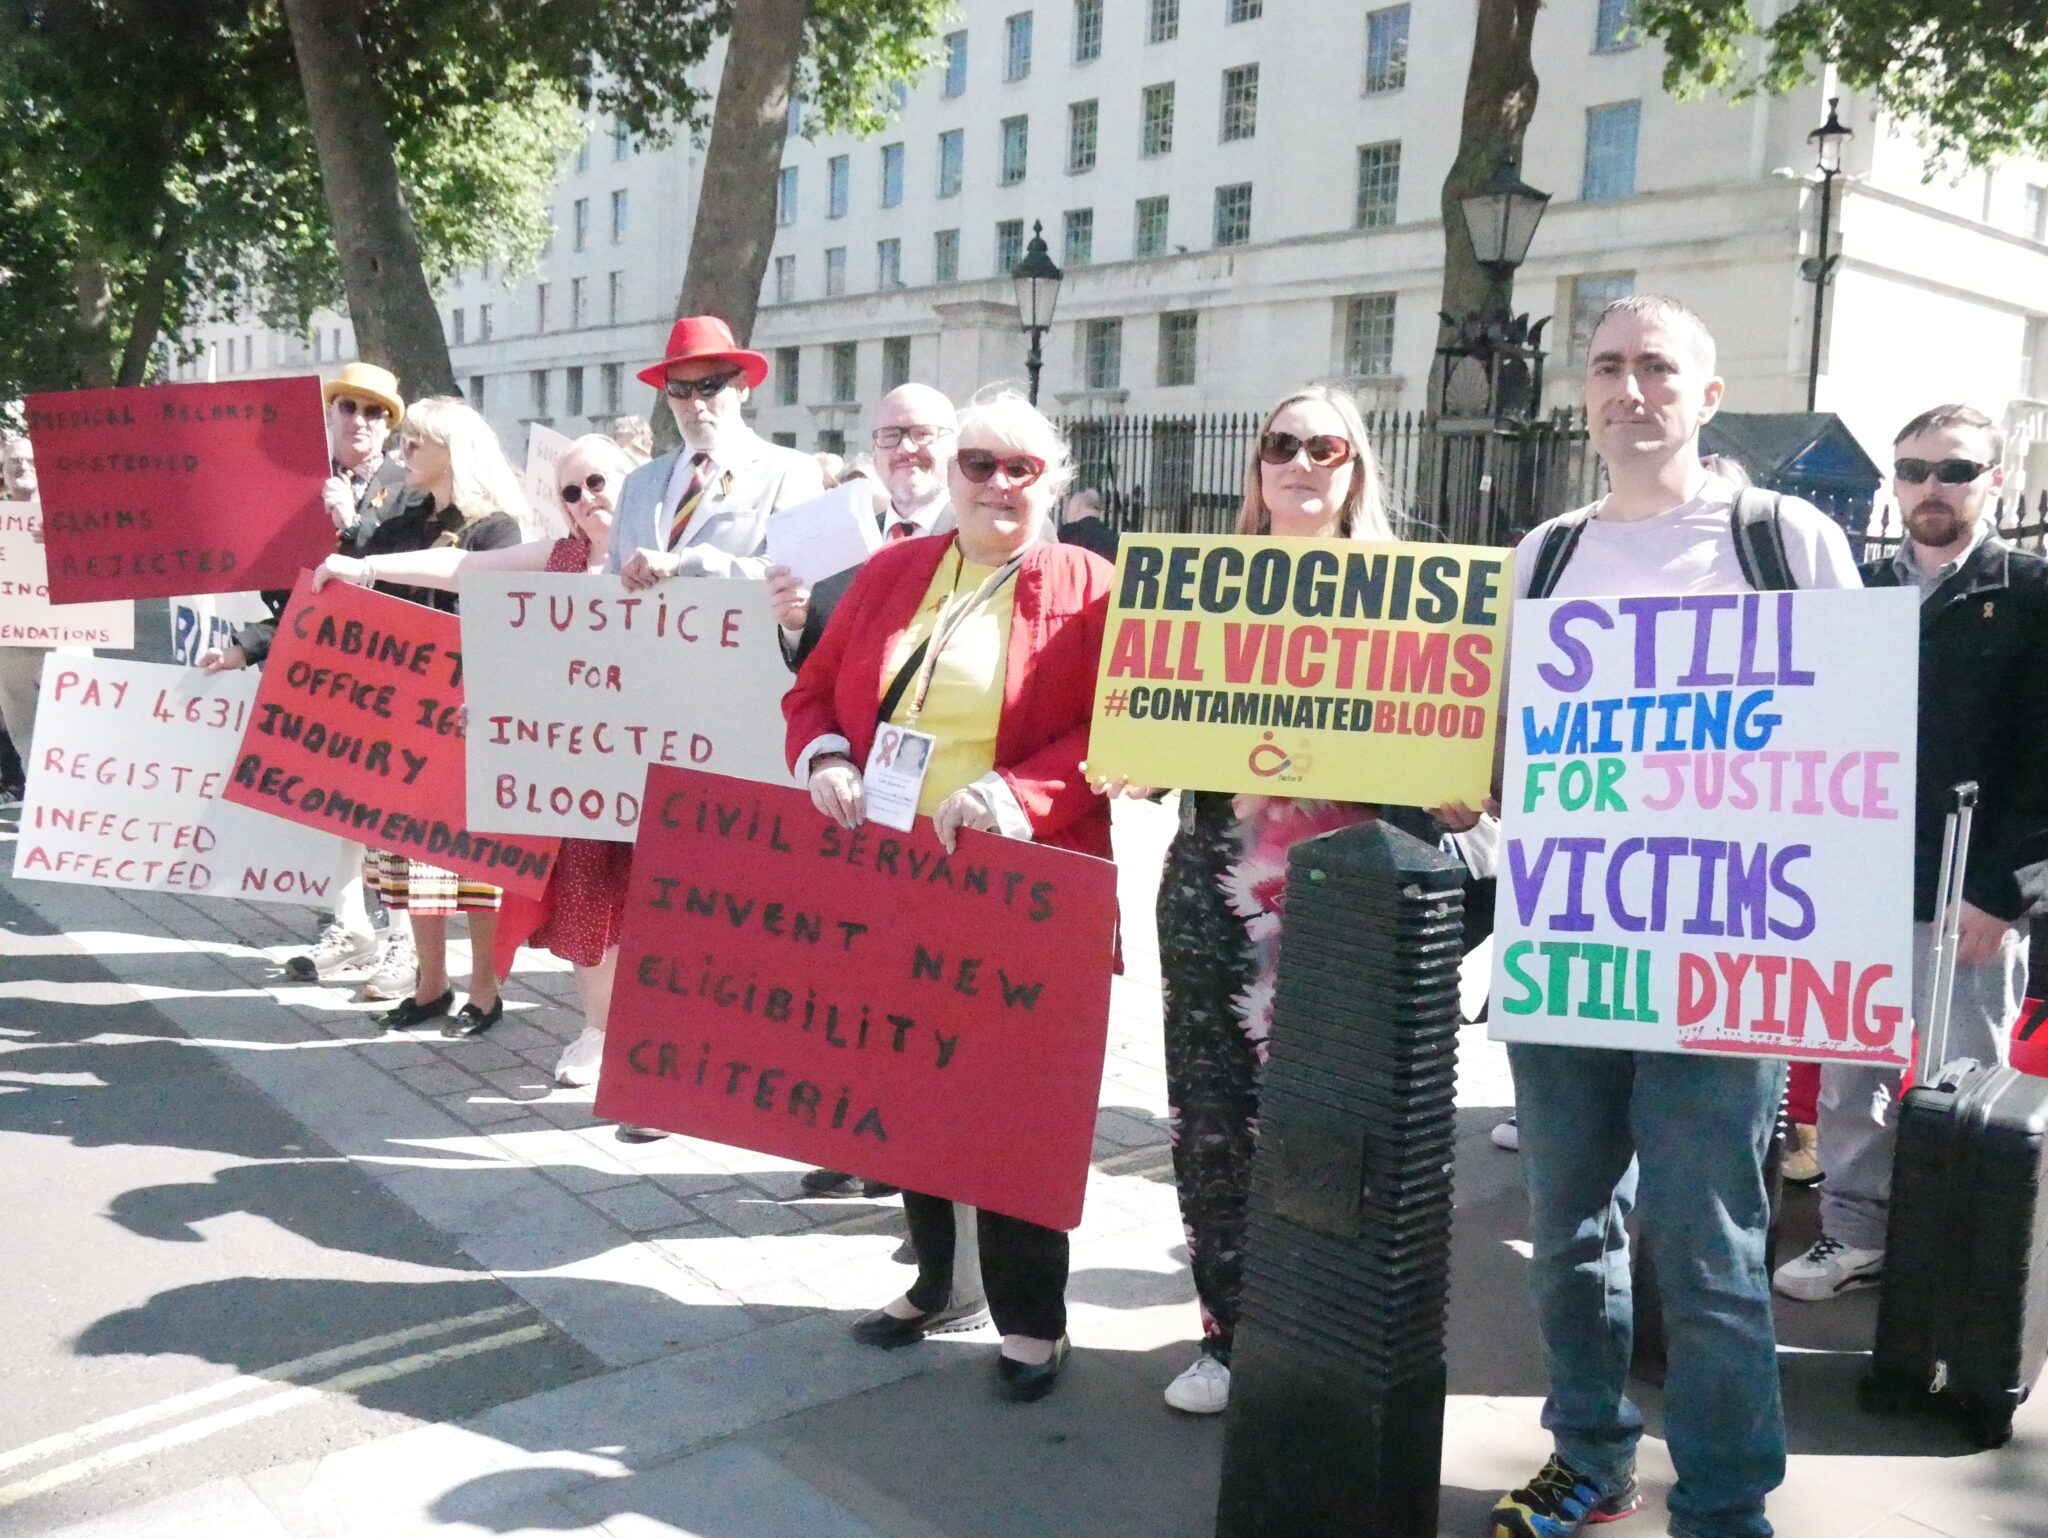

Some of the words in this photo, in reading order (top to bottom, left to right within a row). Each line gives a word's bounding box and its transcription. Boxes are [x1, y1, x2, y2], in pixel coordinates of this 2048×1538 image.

[162, 403, 277, 424] RECORDS
[51, 510, 153, 532] CLAIMS
[2, 581, 49, 597] INQ
[60, 550, 236, 577] REJECTED
[1118, 546, 1501, 626] RECOGNISE
[1, 625, 110, 642] ENDATIONS
[293, 606, 463, 688] CABINET
[507, 591, 743, 648] JUSTICE
[1536, 592, 1816, 693] STILL
[568, 660, 622, 692] FOR
[1107, 618, 1203, 682] ALL
[1224, 622, 1493, 698] VICTIMS
[54, 671, 128, 708] PAY
[153, 690, 245, 732] 4631
[287, 661, 397, 718] OFFICE
[1104, 686, 1486, 739] #CONTAMINATEDBLOOD
[257, 703, 428, 785] INQUIRY
[489, 716, 712, 763] INFECTED
[1522, 689, 1782, 755] WAITING
[44, 747, 221, 800] REGISTE
[496, 773, 639, 827] BLOOD
[1522, 758, 1629, 813] FOR
[1641, 750, 1900, 820] JUSTICE
[35, 806, 216, 852] INFECTED
[234, 754, 550, 880] RECOMMENDATION
[24, 846, 212, 890] AFFECTED
[241, 867, 331, 897] NOW
[819, 825, 1054, 922] SERVANTS
[1507, 837, 1816, 941] VICTIMS
[649, 877, 868, 950] INVENT
[911, 944, 1044, 1010] NEW
[1502, 940, 1659, 1024] STILL
[1677, 951, 1904, 1048] DYING
